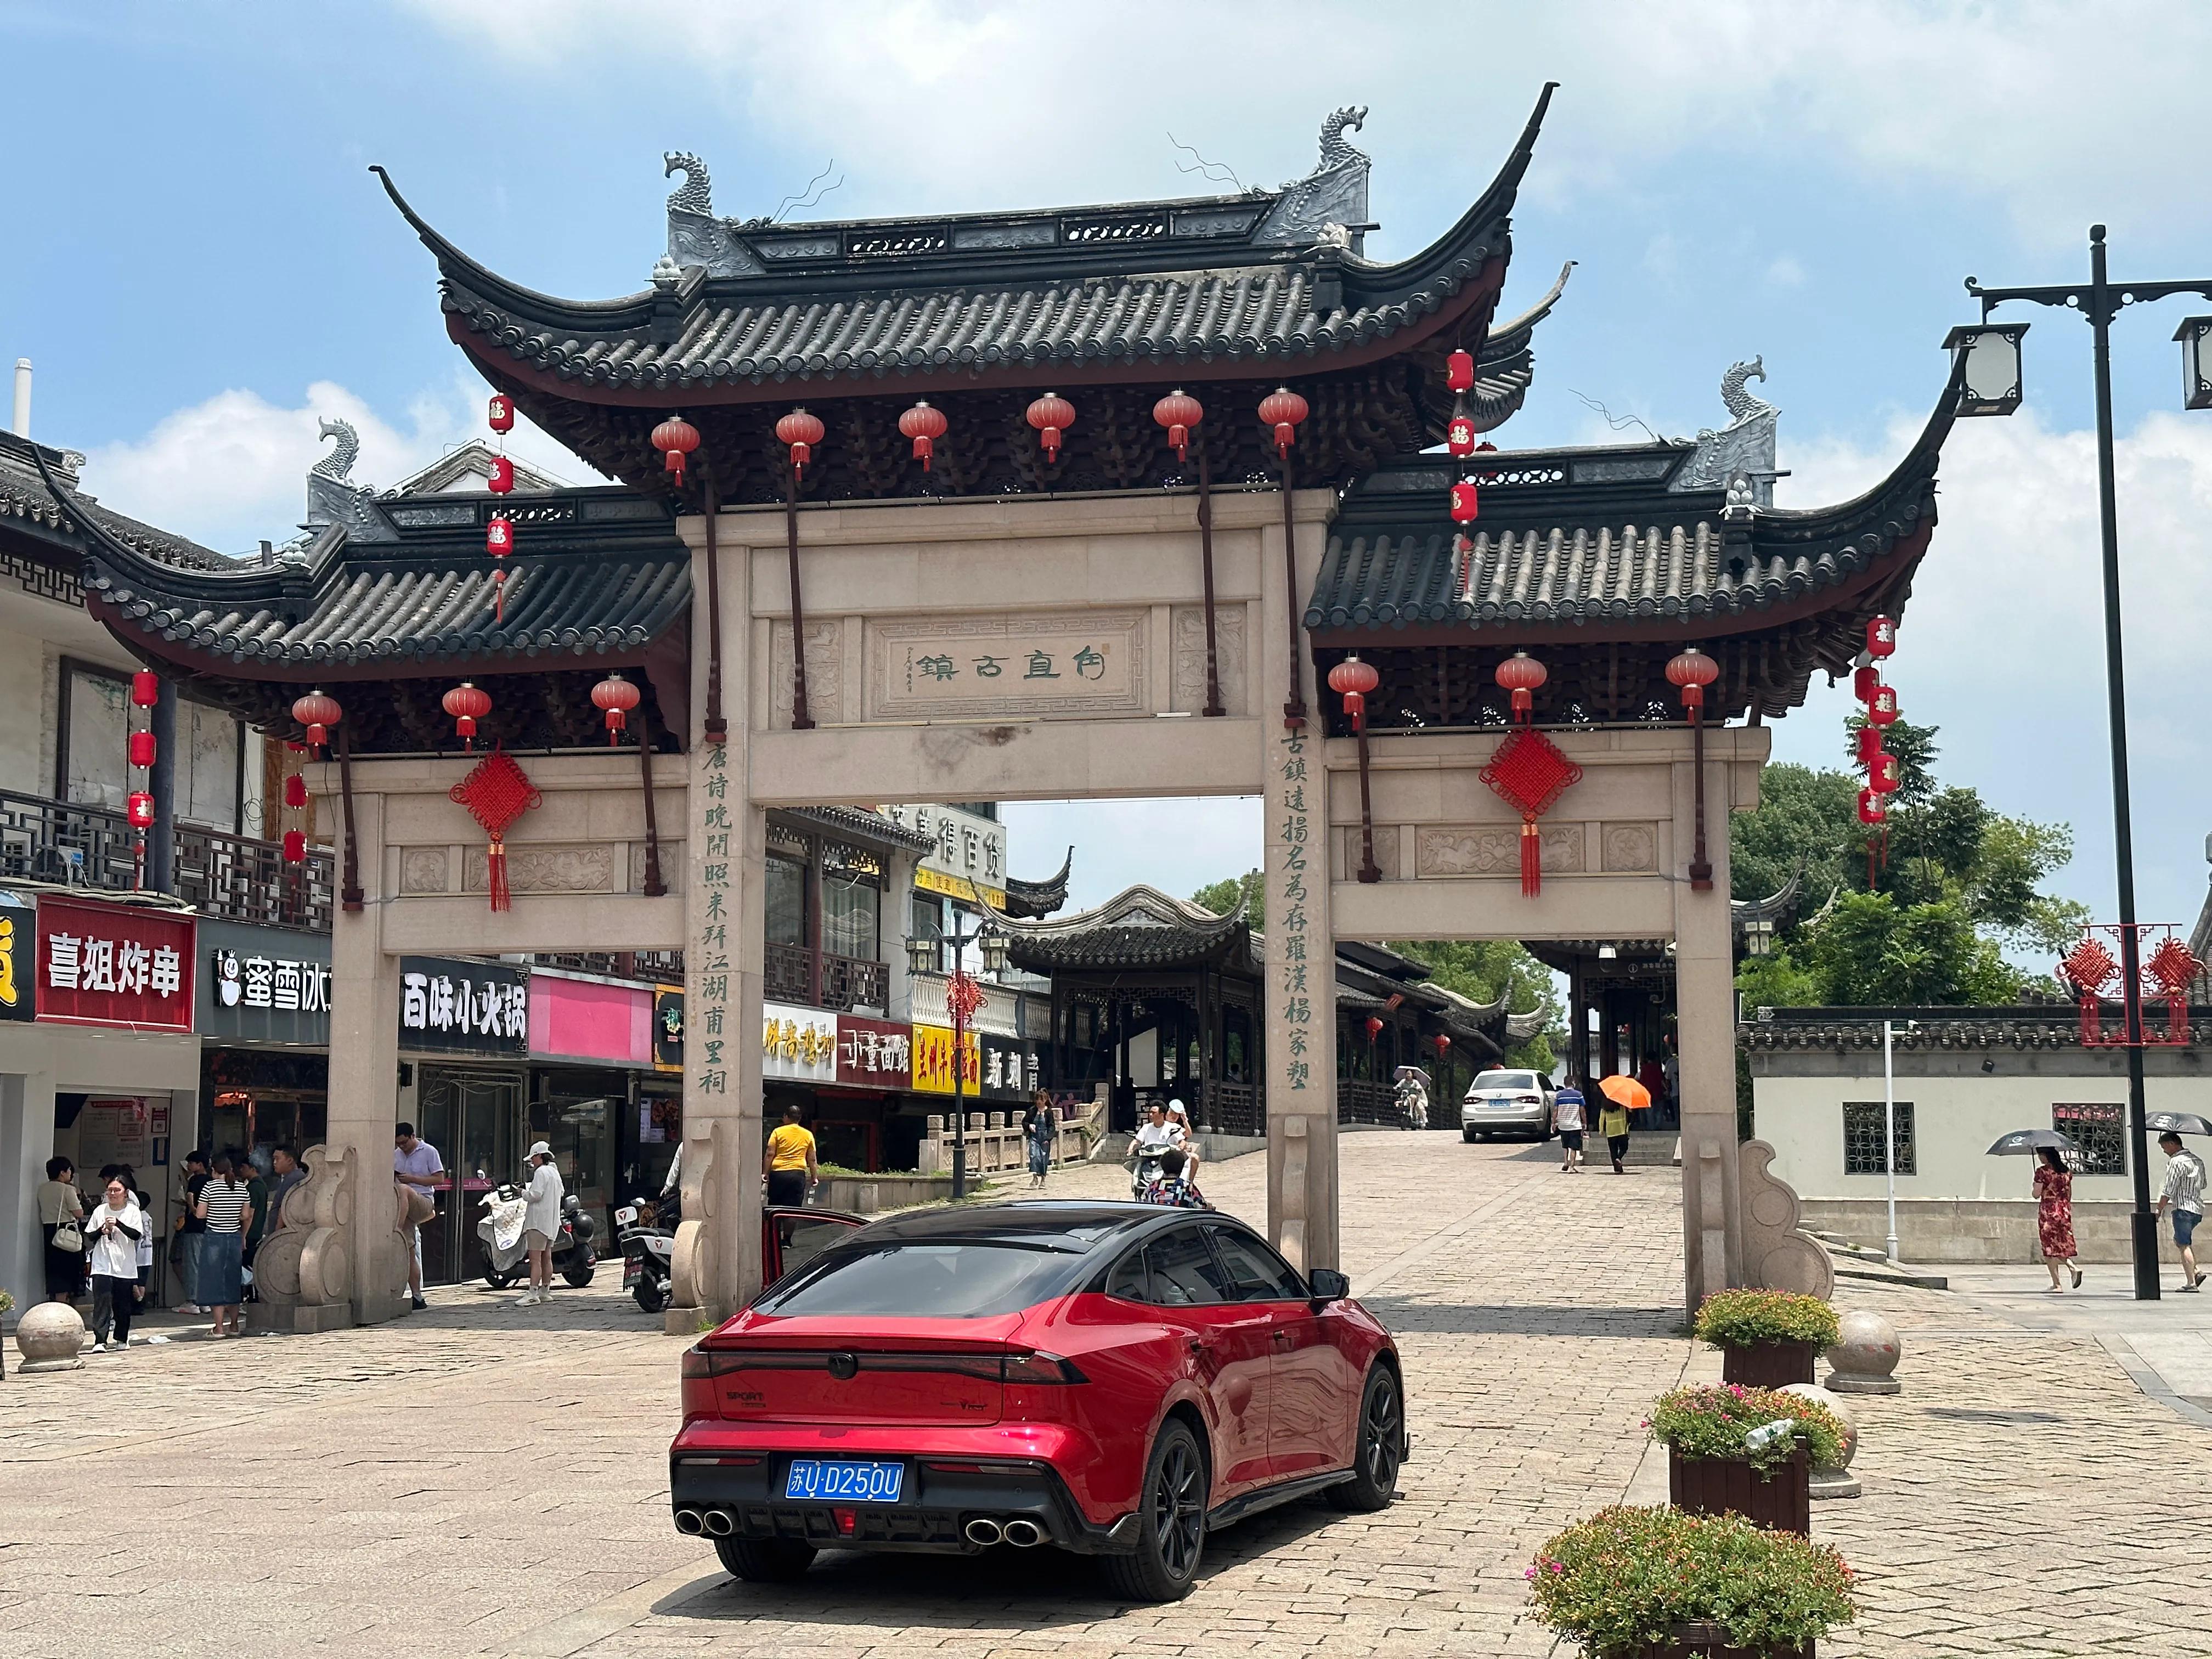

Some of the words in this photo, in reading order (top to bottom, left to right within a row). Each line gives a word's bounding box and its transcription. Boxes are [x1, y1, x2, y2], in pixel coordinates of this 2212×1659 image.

[1451, 425, 1470, 445] 福
[48, 932, 180, 998] 喜姐炸串
[245, 955, 331, 1012] 蜜雪冰
[403, 972, 526, 1038] 百味小火锅
